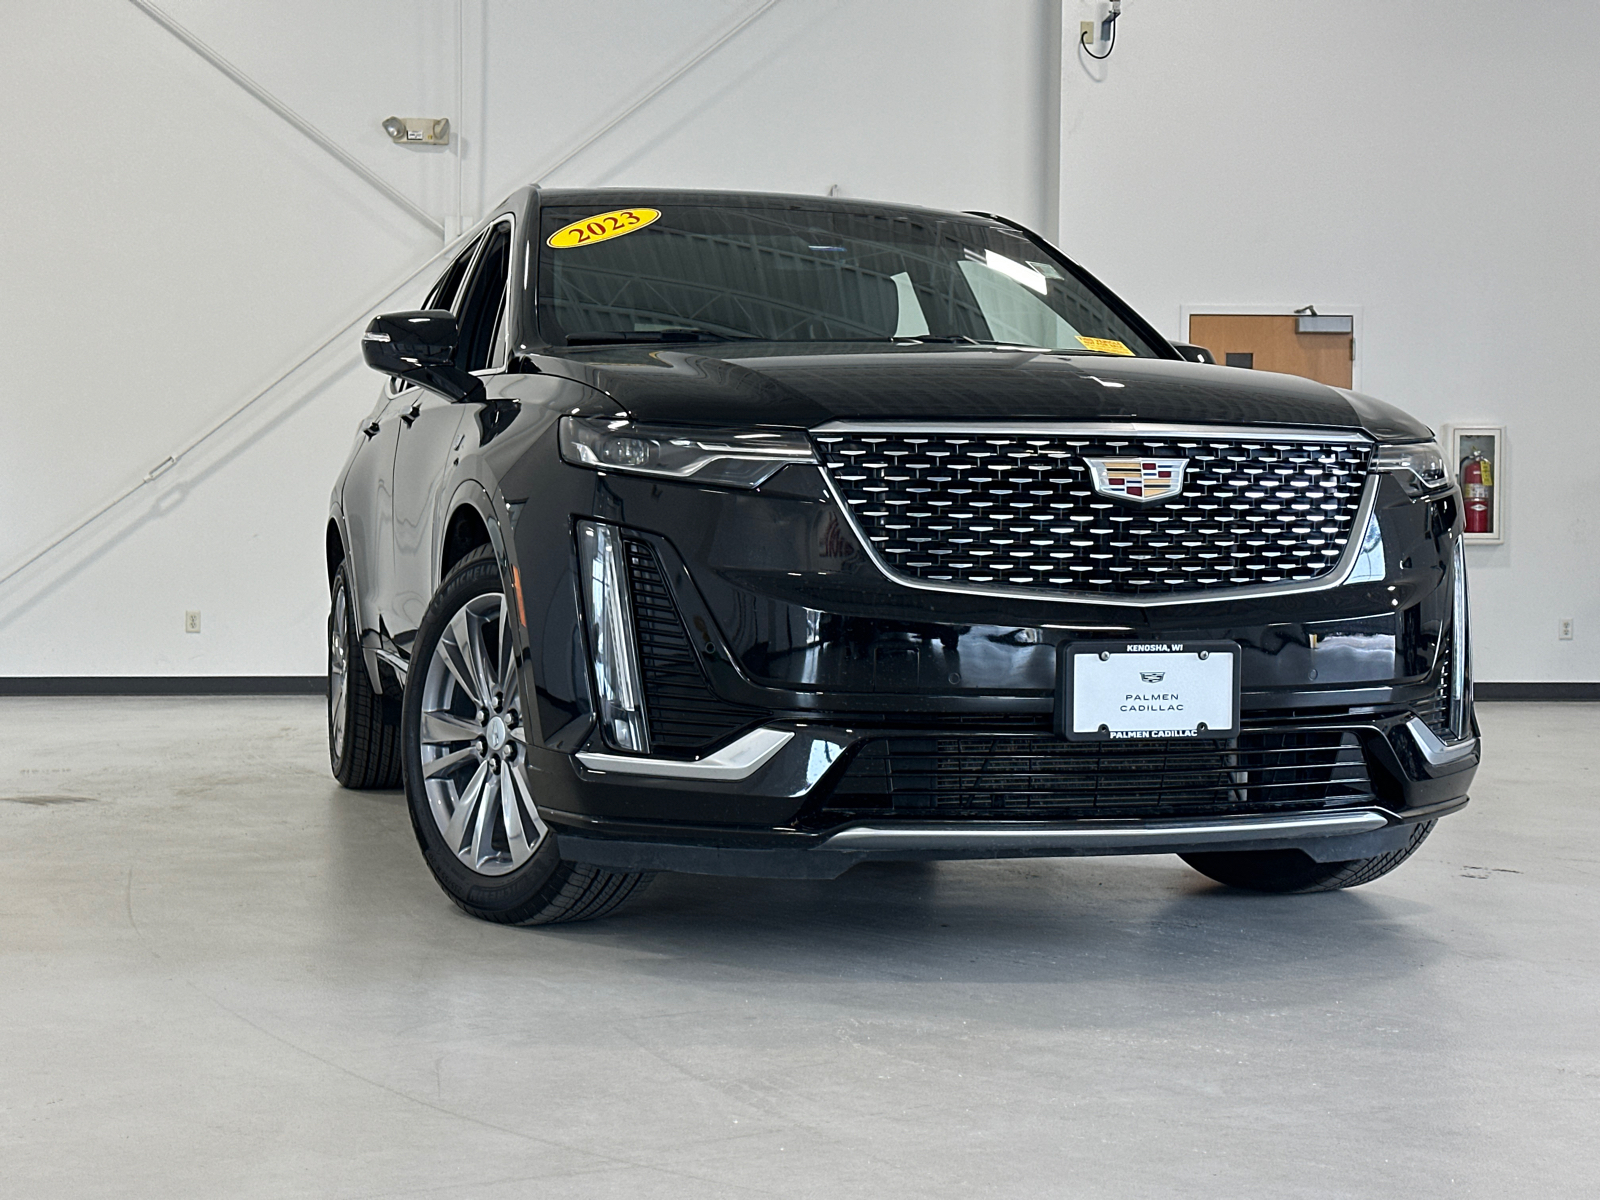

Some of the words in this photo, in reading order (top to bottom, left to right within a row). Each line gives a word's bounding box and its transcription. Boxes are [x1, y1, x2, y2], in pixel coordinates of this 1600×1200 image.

[568, 211, 641, 244] 2023
[1172, 643, 1183, 651] WI
[1125, 693, 1179, 701] PALMEN
[1119, 704, 1184, 712] CADILLAC
[1110, 731, 1149, 739] PALMEN
[1151, 730, 1197, 738] CADILLAC
